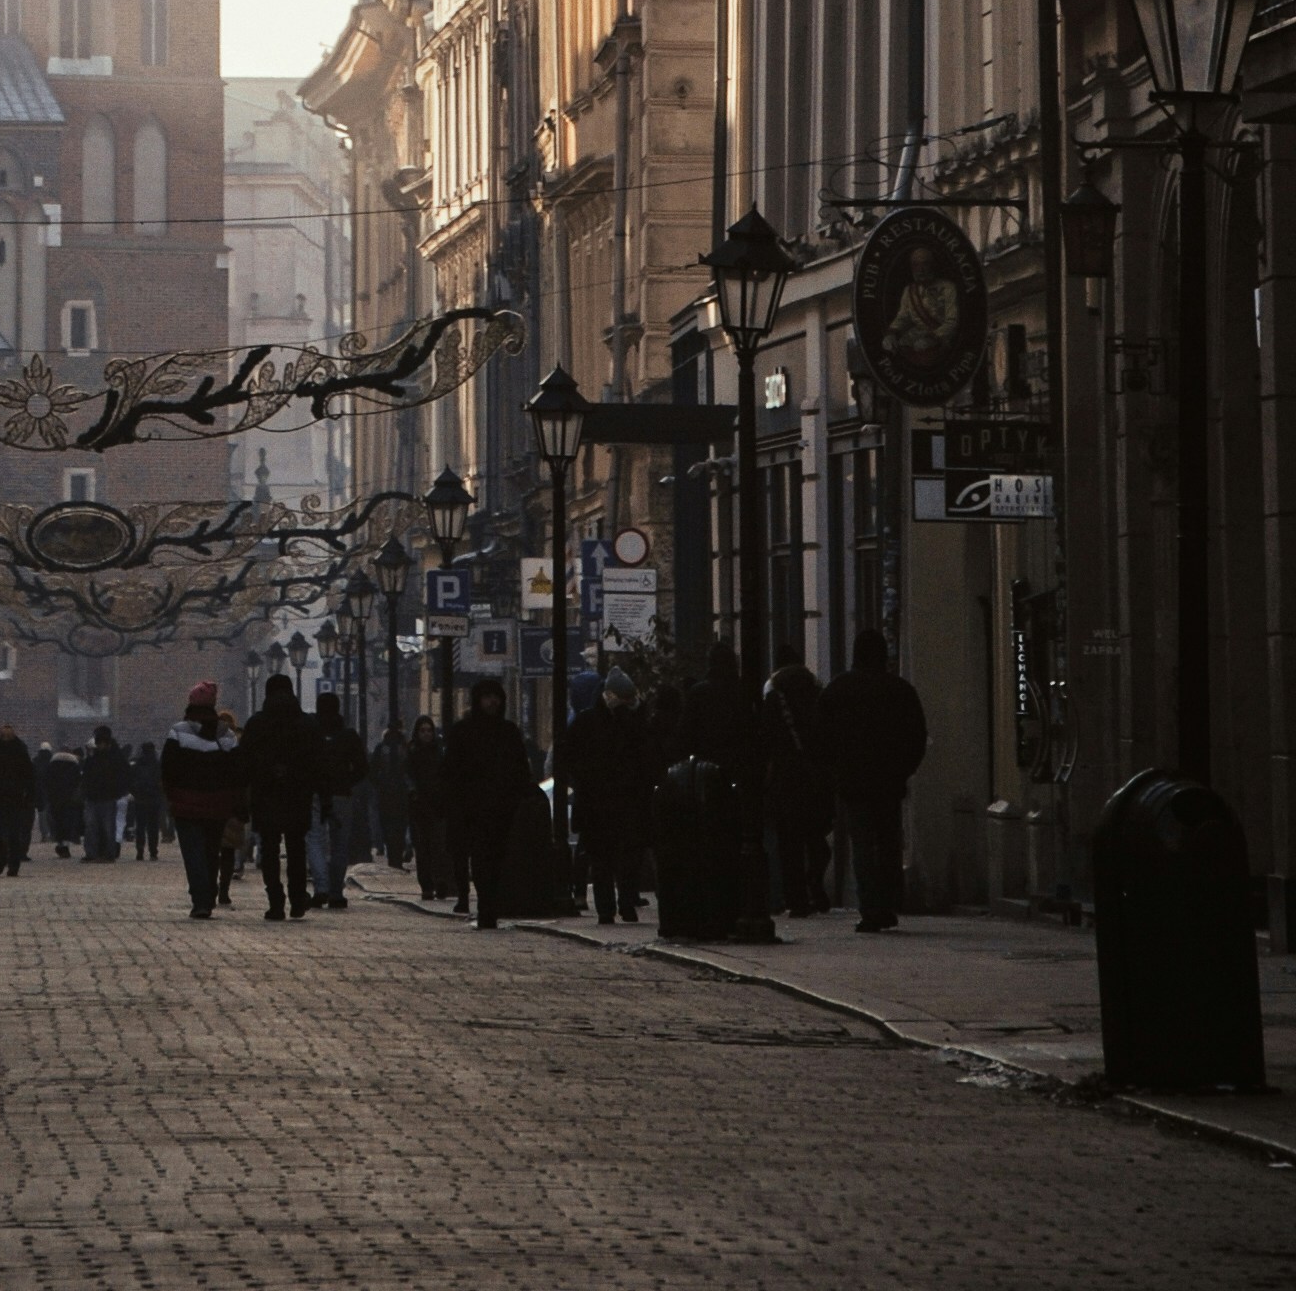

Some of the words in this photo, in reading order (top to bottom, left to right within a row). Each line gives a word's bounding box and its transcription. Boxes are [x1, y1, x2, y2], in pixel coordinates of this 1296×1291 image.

[863, 262, 882, 299] PUB
[880, 217, 977, 294] RESTAURACJA
[878, 356, 904, 385] Pod
[961, 426, 1050, 459] OPTYK
[437, 575, 461, 609] P
